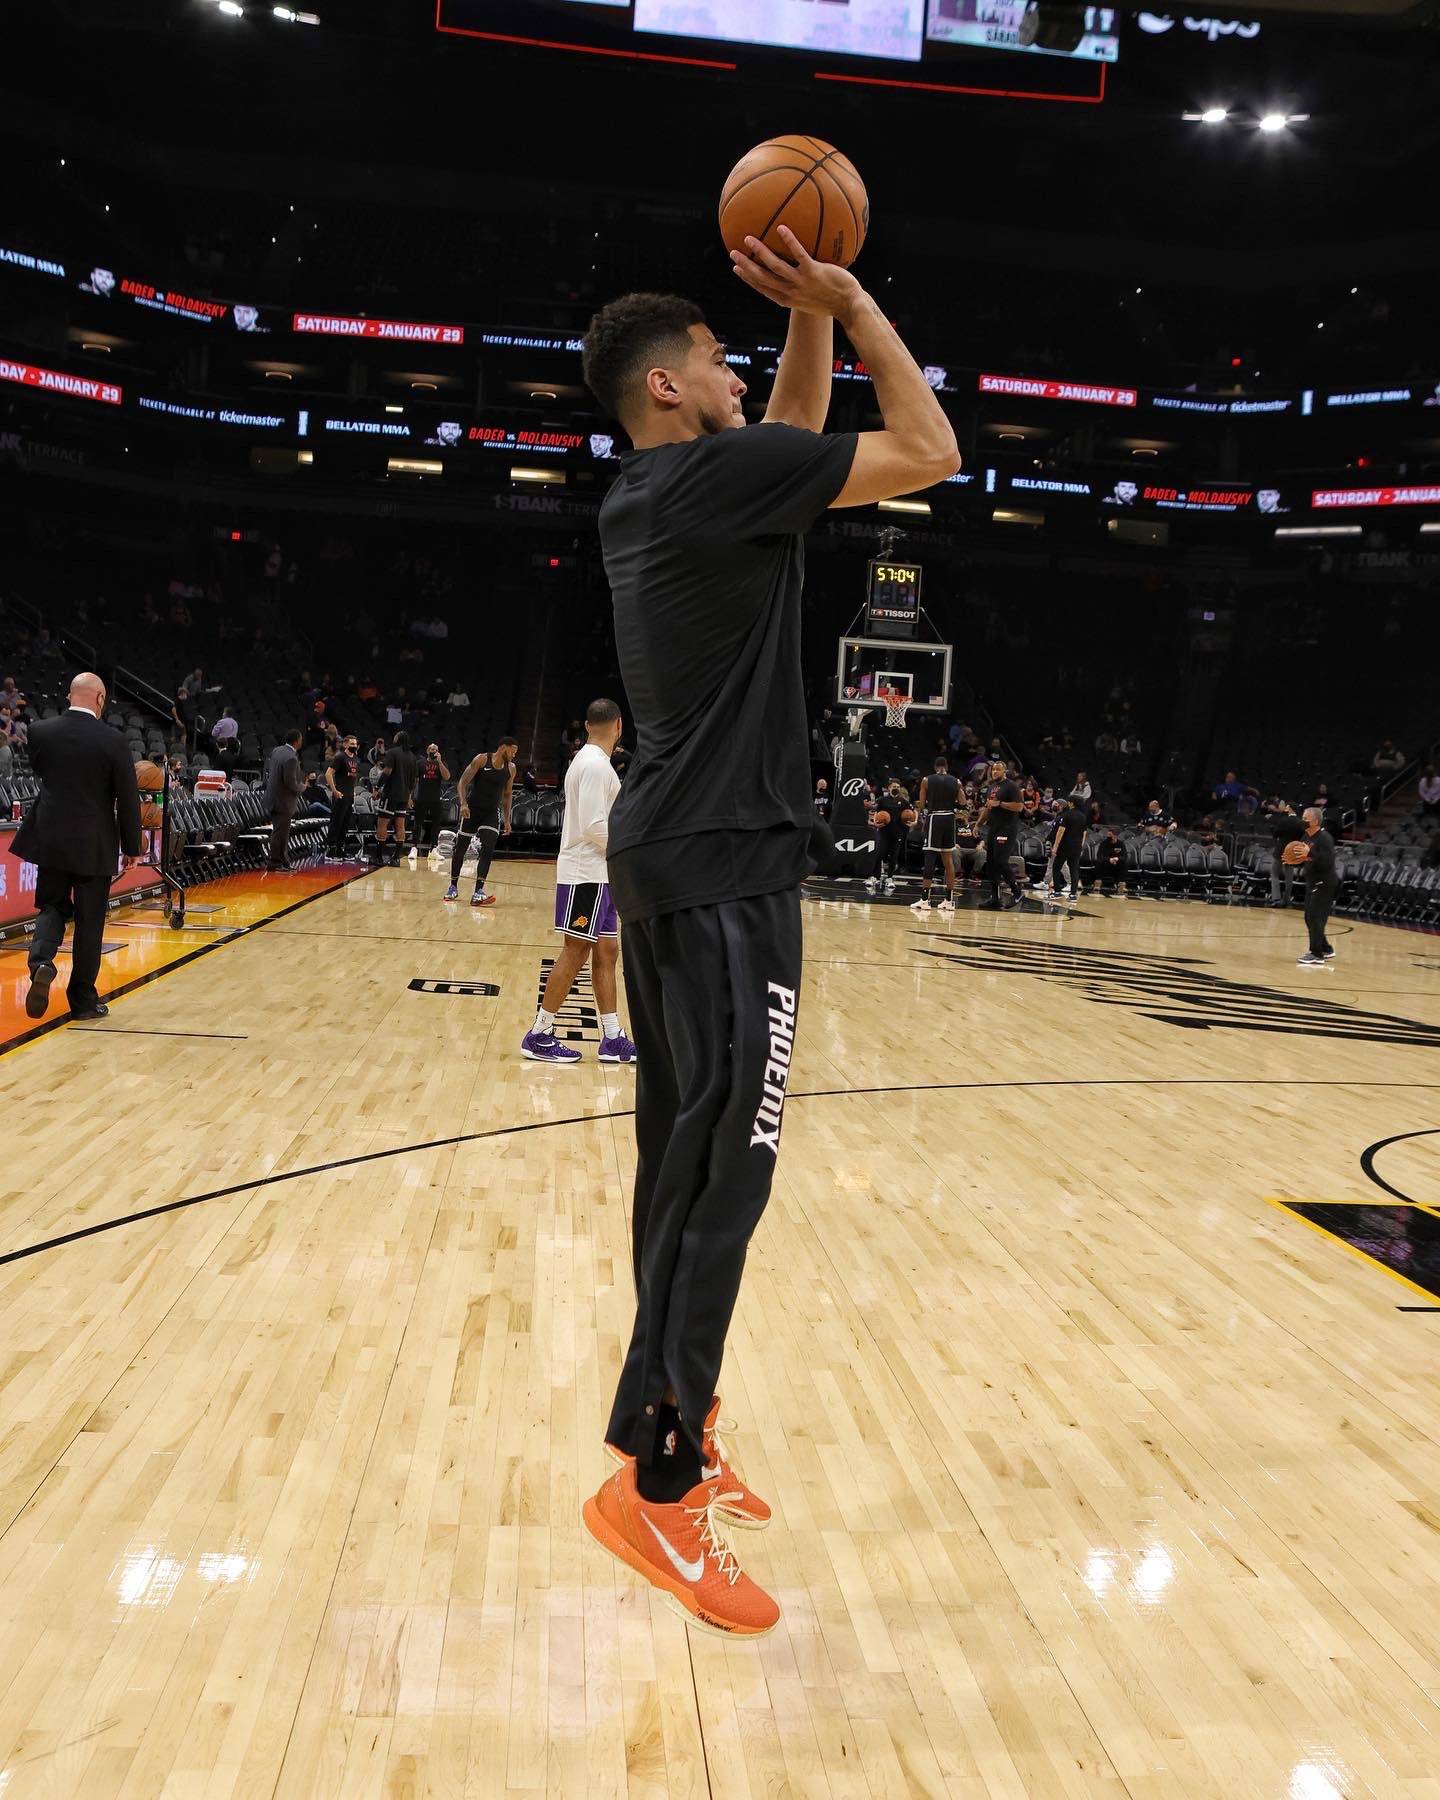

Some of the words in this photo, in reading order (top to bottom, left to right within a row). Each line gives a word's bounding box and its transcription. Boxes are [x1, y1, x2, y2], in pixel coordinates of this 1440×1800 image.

[120, 278, 155, 299] BADER
[297, 316, 366, 335] SATURDAY
[378, 323, 439, 341] JANUARY
[442, 328, 461, 342] 29
[482, 334, 512, 346] TICKETS
[513, 337, 551, 348] AVAILABLE
[552, 340, 562, 349] AT
[38, 370, 99, 398] JANUARY
[101, 385, 119, 402] 29
[982, 377, 1047, 395] SATURDAY
[1056, 385, 1115, 402] JANUARY
[1116, 391, 1134, 404] 29
[139, 396, 166, 412] TICKETS
[167, 404, 204, 418] AVAILABLE
[205, 411, 215, 420] AT
[219, 409, 282, 428] ticketmaster
[325, 419, 381, 434] BELLATOR
[381, 423, 411, 436] MMA
[468, 427, 505, 441] BADER
[517, 430, 584, 448] MOLDAVSKY
[1011, 477, 1063, 491] BELLATOR
[1063, 482, 1091, 494] MMA
[1143, 486, 1177, 501] BADER
[1188, 491, 1252, 505] MOLDAVSKY
[1314, 490, 1383, 506] SATURDAY
[877, 567, 915, 583] 57:04
[883, 609, 916, 619] TISSOT
[749, 981, 796, 1155] PHOENIX
